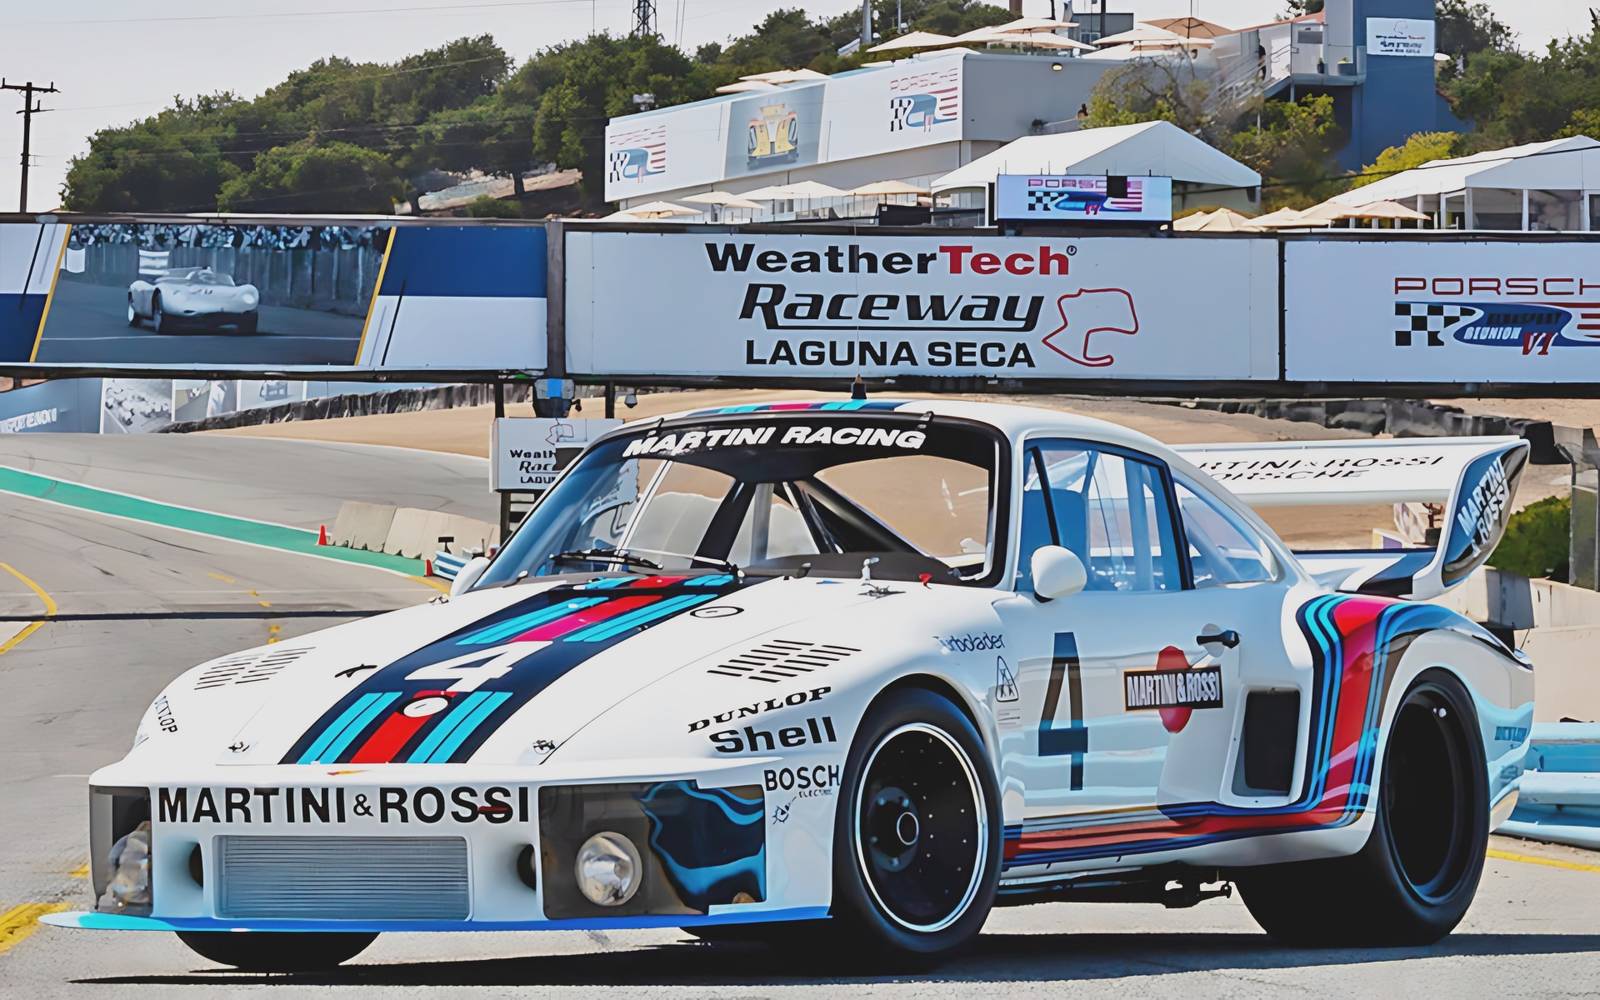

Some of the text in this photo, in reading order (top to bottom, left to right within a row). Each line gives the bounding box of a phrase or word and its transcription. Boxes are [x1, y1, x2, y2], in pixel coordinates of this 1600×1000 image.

[705, 242, 1069, 276] WeatherTech
[738, 283, 1045, 332] Raceway
[746, 340, 1036, 368] LAGUNA SECA
[622, 426, 926, 457] MARTINI RACING
[404, 640, 553, 693] 4
[688, 686, 831, 733] DUNLOP
[1038, 632, 1088, 790] 4
[709, 717, 837, 753] Shell
[763, 764, 840, 791] BOSCH
